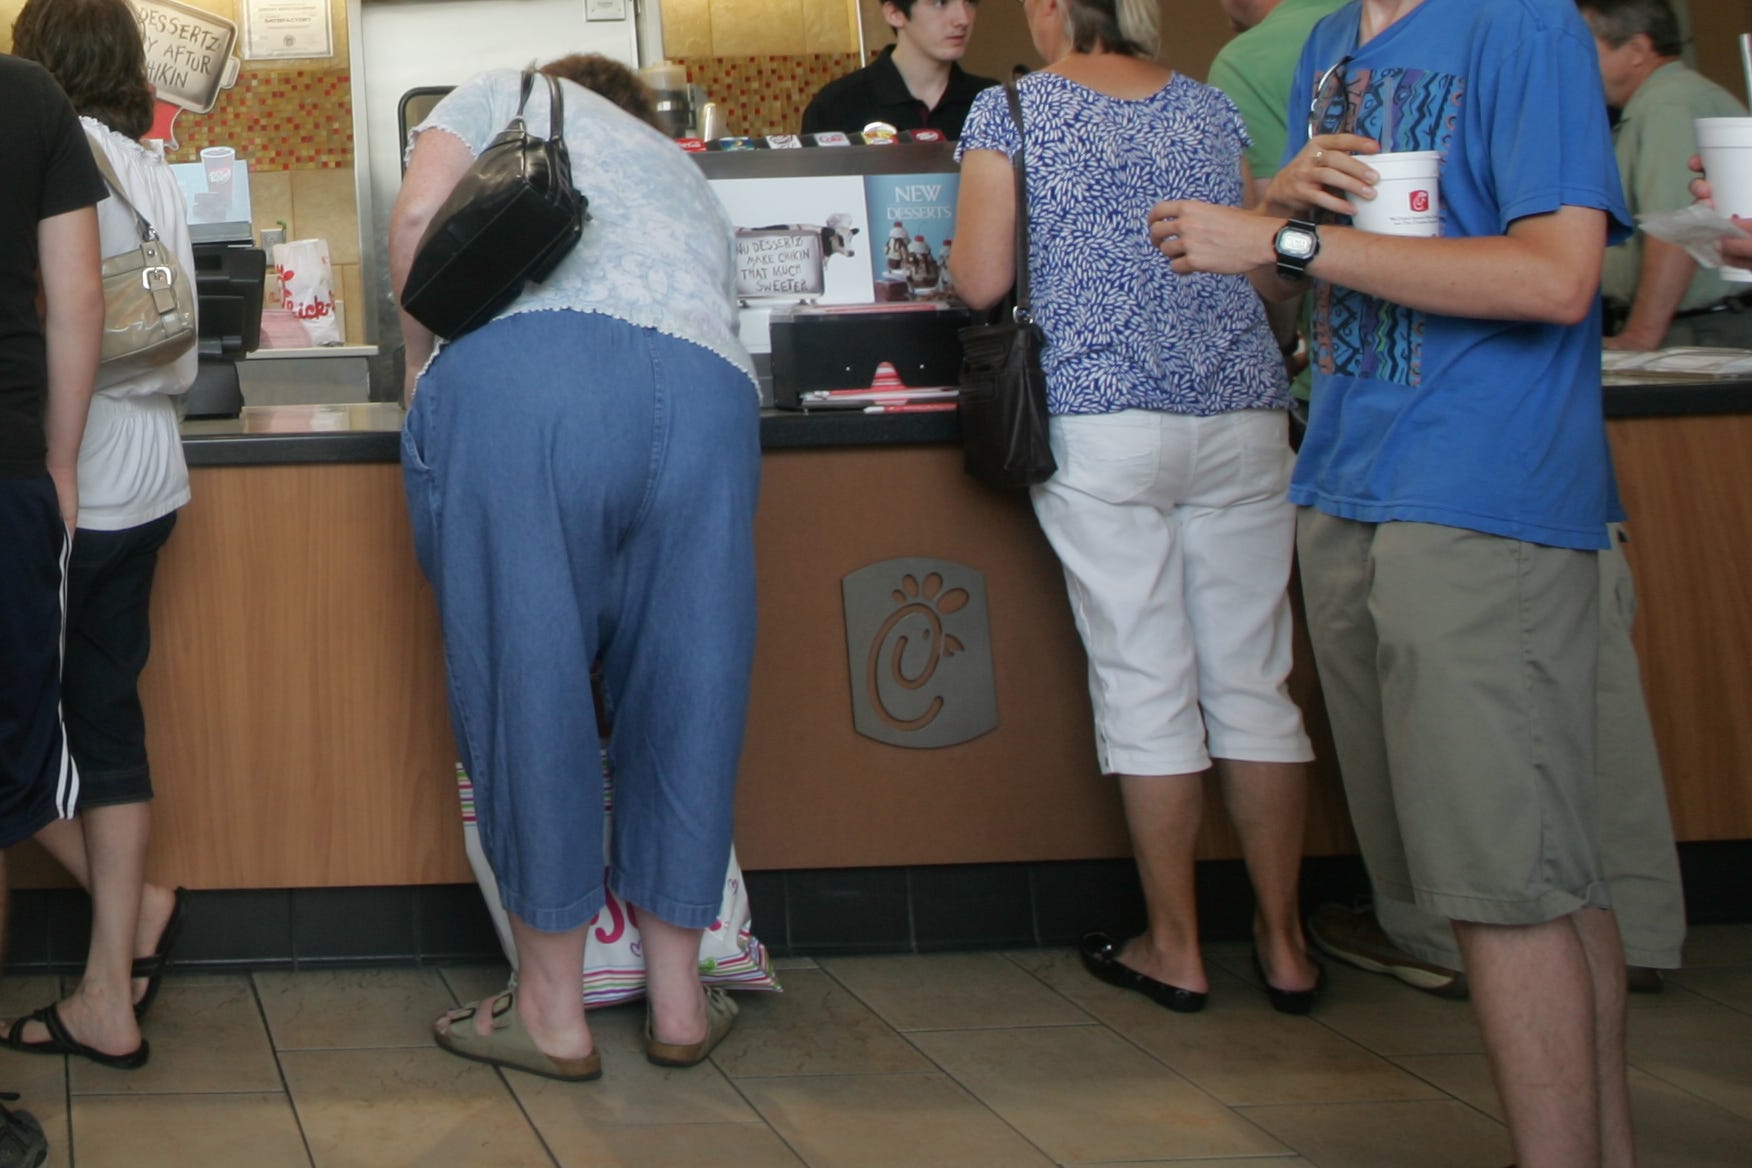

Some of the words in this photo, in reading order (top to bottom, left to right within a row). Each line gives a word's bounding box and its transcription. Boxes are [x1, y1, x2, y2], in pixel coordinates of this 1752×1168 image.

[163, 44, 211, 75] AFTUR
[147, 60, 188, 88] HIKIN
[895, 184, 942, 202] NEW
[887, 206, 952, 220] DESSERTS
[752, 236, 803, 252] DESSERTZ
[747, 255, 774, 265] MAKE
[741, 268, 767, 280] THAT
[773, 264, 801, 277] MUCH
[756, 279, 808, 292] SWEETER
